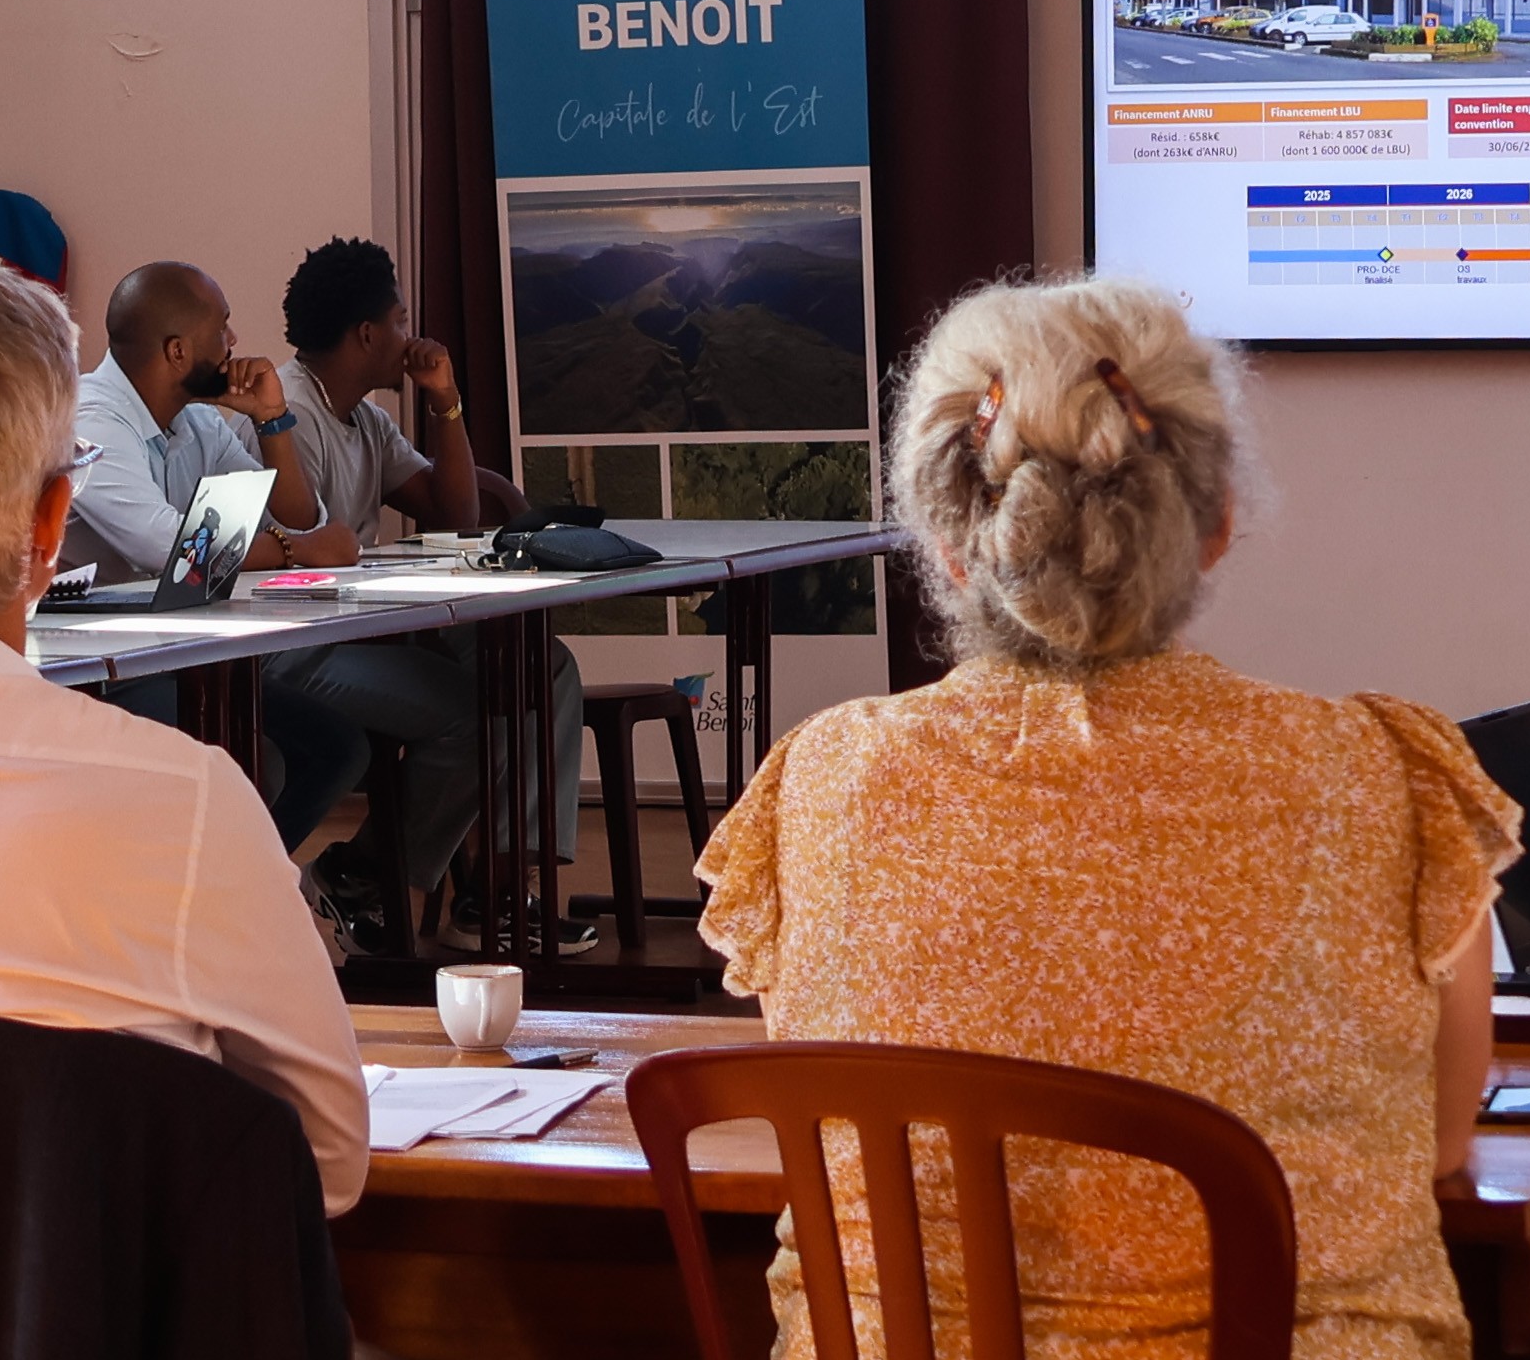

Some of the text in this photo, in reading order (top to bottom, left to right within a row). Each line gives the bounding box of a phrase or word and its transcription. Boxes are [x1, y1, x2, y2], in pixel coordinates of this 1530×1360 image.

[557, 82, 670, 142] Capitale
[687, 82, 714, 128] de
[1114, 109, 1213, 119] Financement ANRU
[1271, 107, 1361, 117] Financement LBU
[1454, 104, 1479, 114] Date
[1482, 103, 1513, 113] limite
[1454, 119, 1514, 129] convention
[1151, 131, 1220, 142] Résid. 658k€
[1299, 129, 1393, 140] Réhab: 4 857 083€
[1133, 147, 1160, 159] (dont
[1163, 147, 1193, 157] 263k€
[1281, 145, 1309, 156] (dont
[1320, 146, 1340, 155] 600
[1342, 145, 1368, 155] 000€
[1370, 144, 1384, 154] de
[1387, 144, 1410, 156] LBU)
[1304, 190, 1331, 201] 2025
[1446, 189, 1473, 200] 2026
[1357, 265, 1400, 274] PRO- DCE
[1457, 265, 1470, 273] OS
[1457, 276, 1487, 284] travaux
